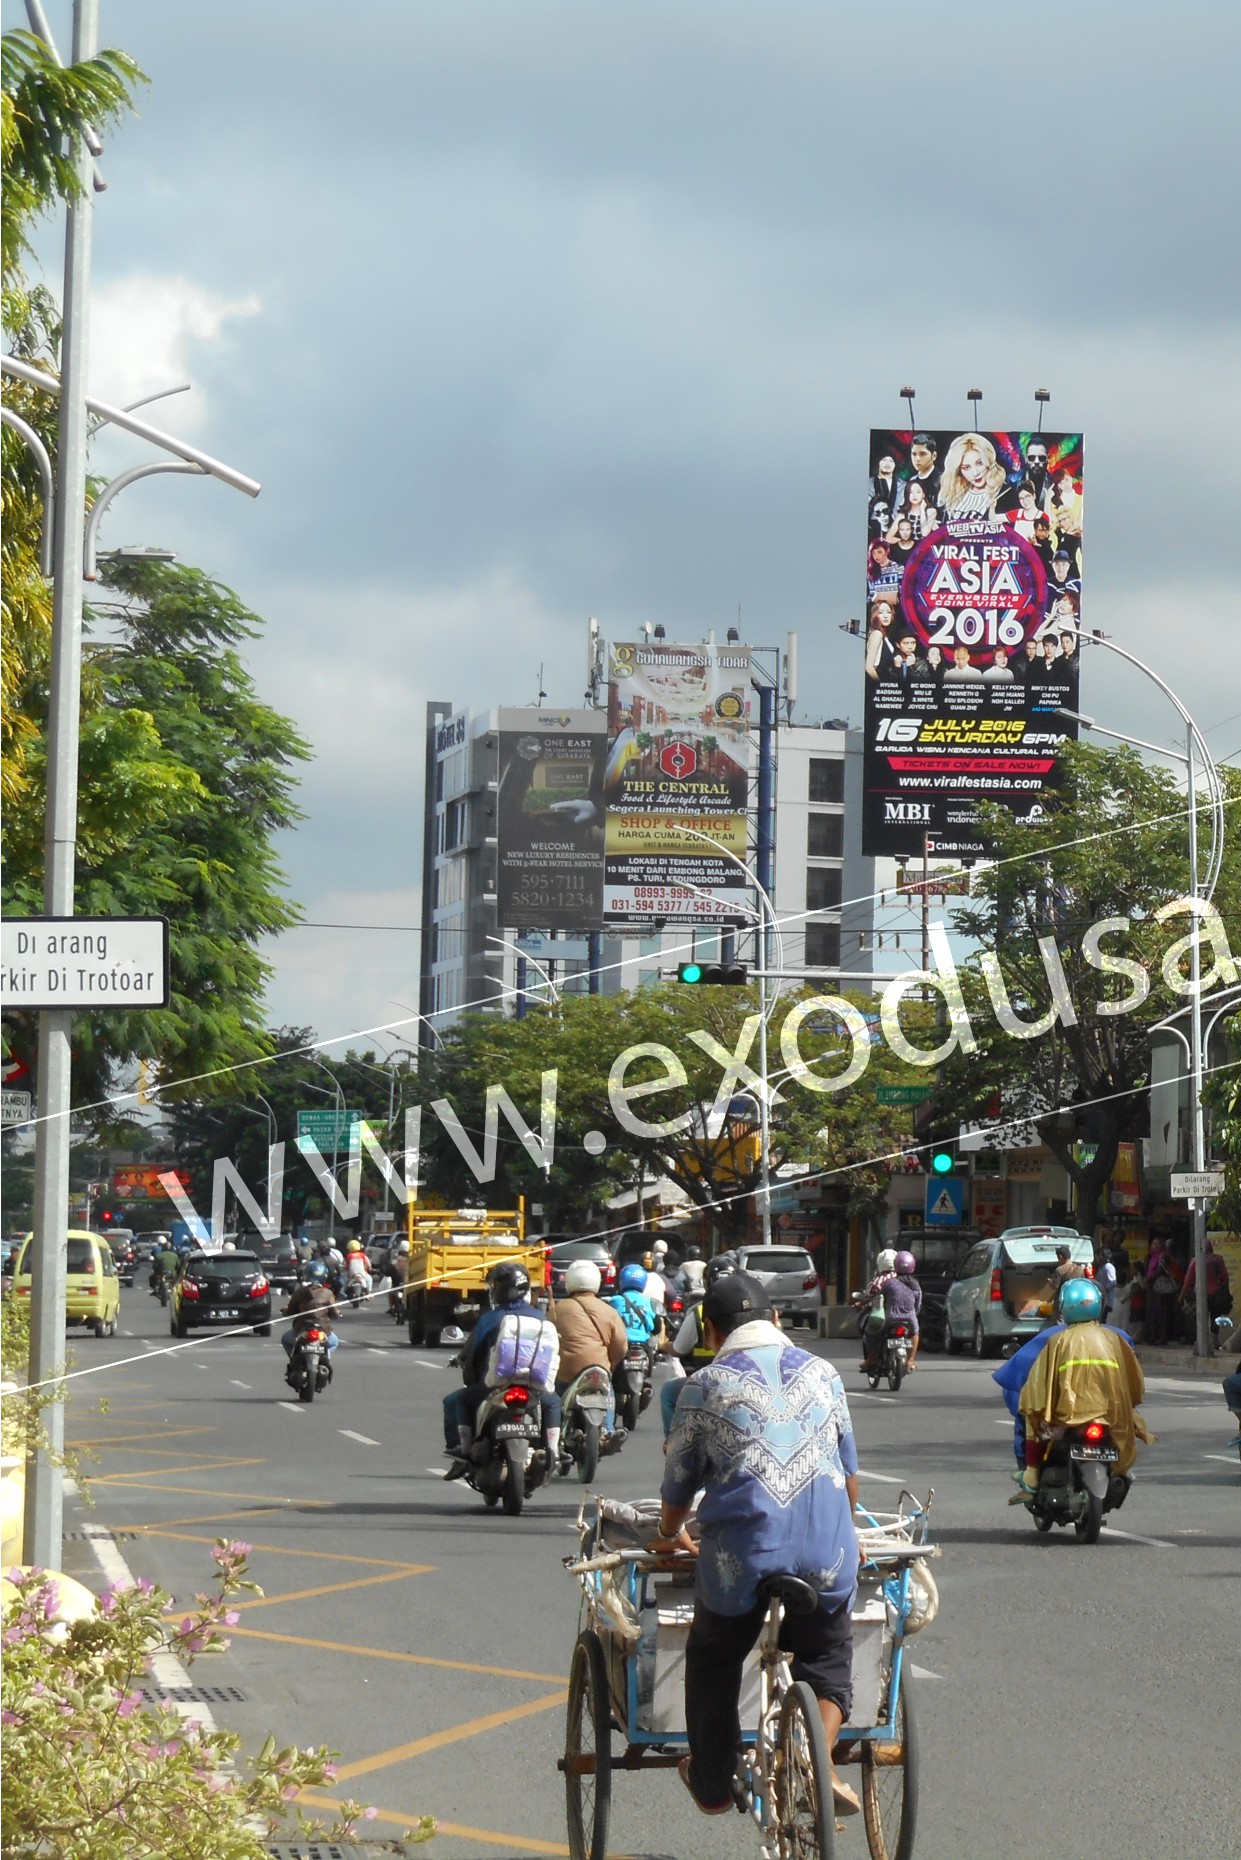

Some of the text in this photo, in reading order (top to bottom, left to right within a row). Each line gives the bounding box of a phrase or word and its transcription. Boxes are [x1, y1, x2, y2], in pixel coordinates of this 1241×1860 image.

[933, 545, 1019, 560] VIRAL FEST
[930, 562, 1020, 594] ASIA
[928, 608, 1024, 645] 2016
[636, 653, 748, 668] GUNAWANGSA TIDAR
[876, 718, 1026, 741] 16 JULY 2016
[919, 732, 1067, 745] SATURDAY 6PM
[903, 760, 950, 768] TICKETS
[624, 781, 729, 794] THE CENTRAL
[899, 776, 1042, 789] www.viralfestasia.com
[656, 794, 697, 805] Lifestyle
[699, 796, 731, 804] Arcade
[608, 804, 736, 816] Segera Launching Tower
[884, 803, 931, 820] MBI
[621, 818, 731, 830] SHOP & OFFICE
[531, 842, 575, 850] WELCOME
[707, 868, 744, 876] MALANG,
[667, 876, 726, 884] KEDUNGDORO
[612, 899, 712, 912] 031-594 5377 545
[48, 969, 66, 991] Di
[77, 969, 154, 991] Trotoar
